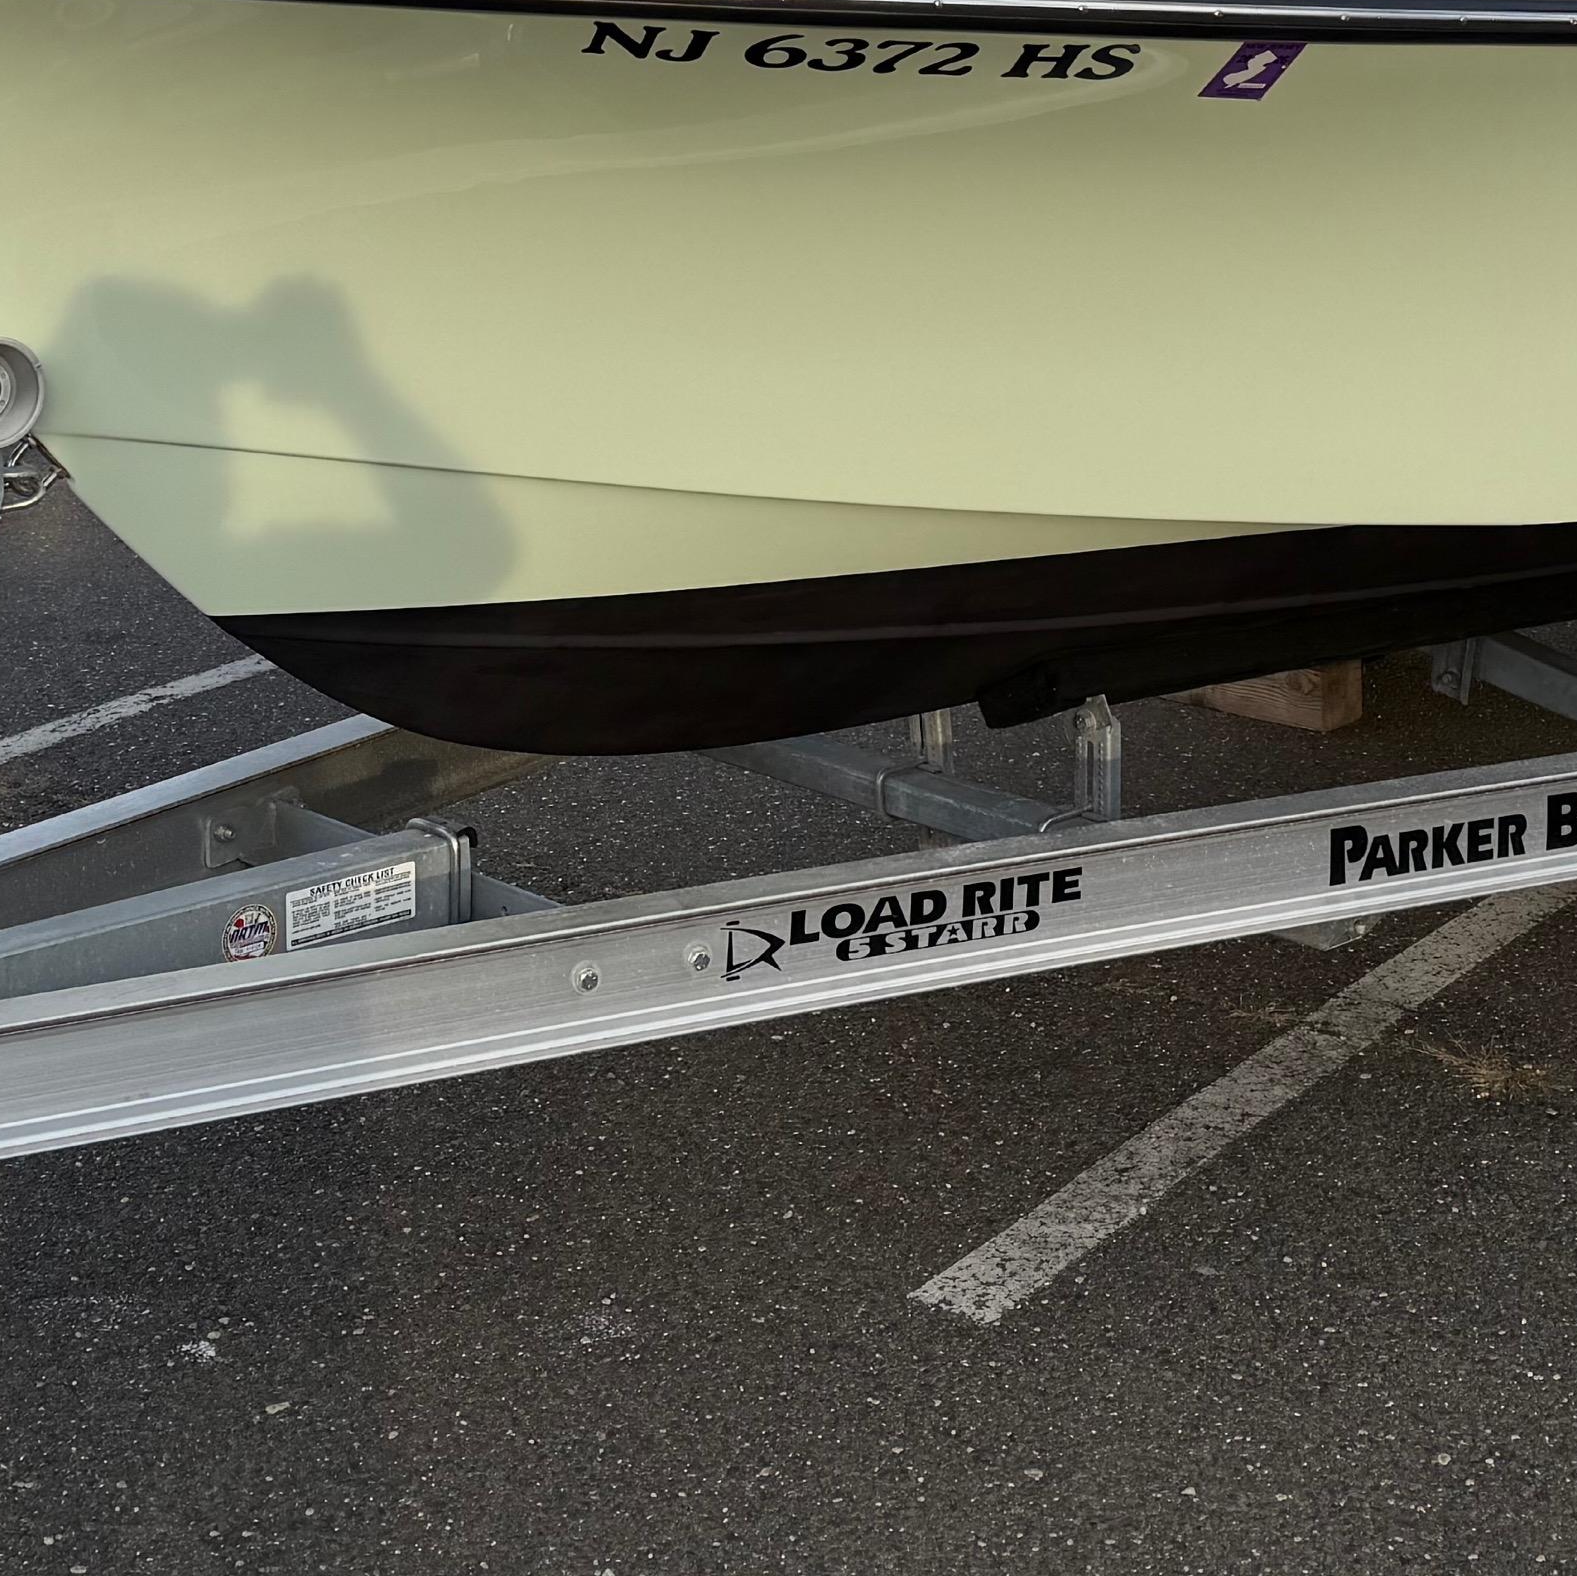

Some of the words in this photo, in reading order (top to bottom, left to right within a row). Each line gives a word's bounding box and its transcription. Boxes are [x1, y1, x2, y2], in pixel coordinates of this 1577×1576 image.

[581, 21, 721, 62] NJ
[743, 34, 980, 79] 6372
[1000, 42, 1142, 82] HS
[309, 881, 343, 897] SAFETY
[345, 874, 375, 888] CHECK
[376, 867, 395, 879] LIST
[790, 889, 947, 946] LOAD
[962, 867, 1083, 918] RITE
[848, 937, 871, 959] 5
[884, 912, 1030, 953] STARR
